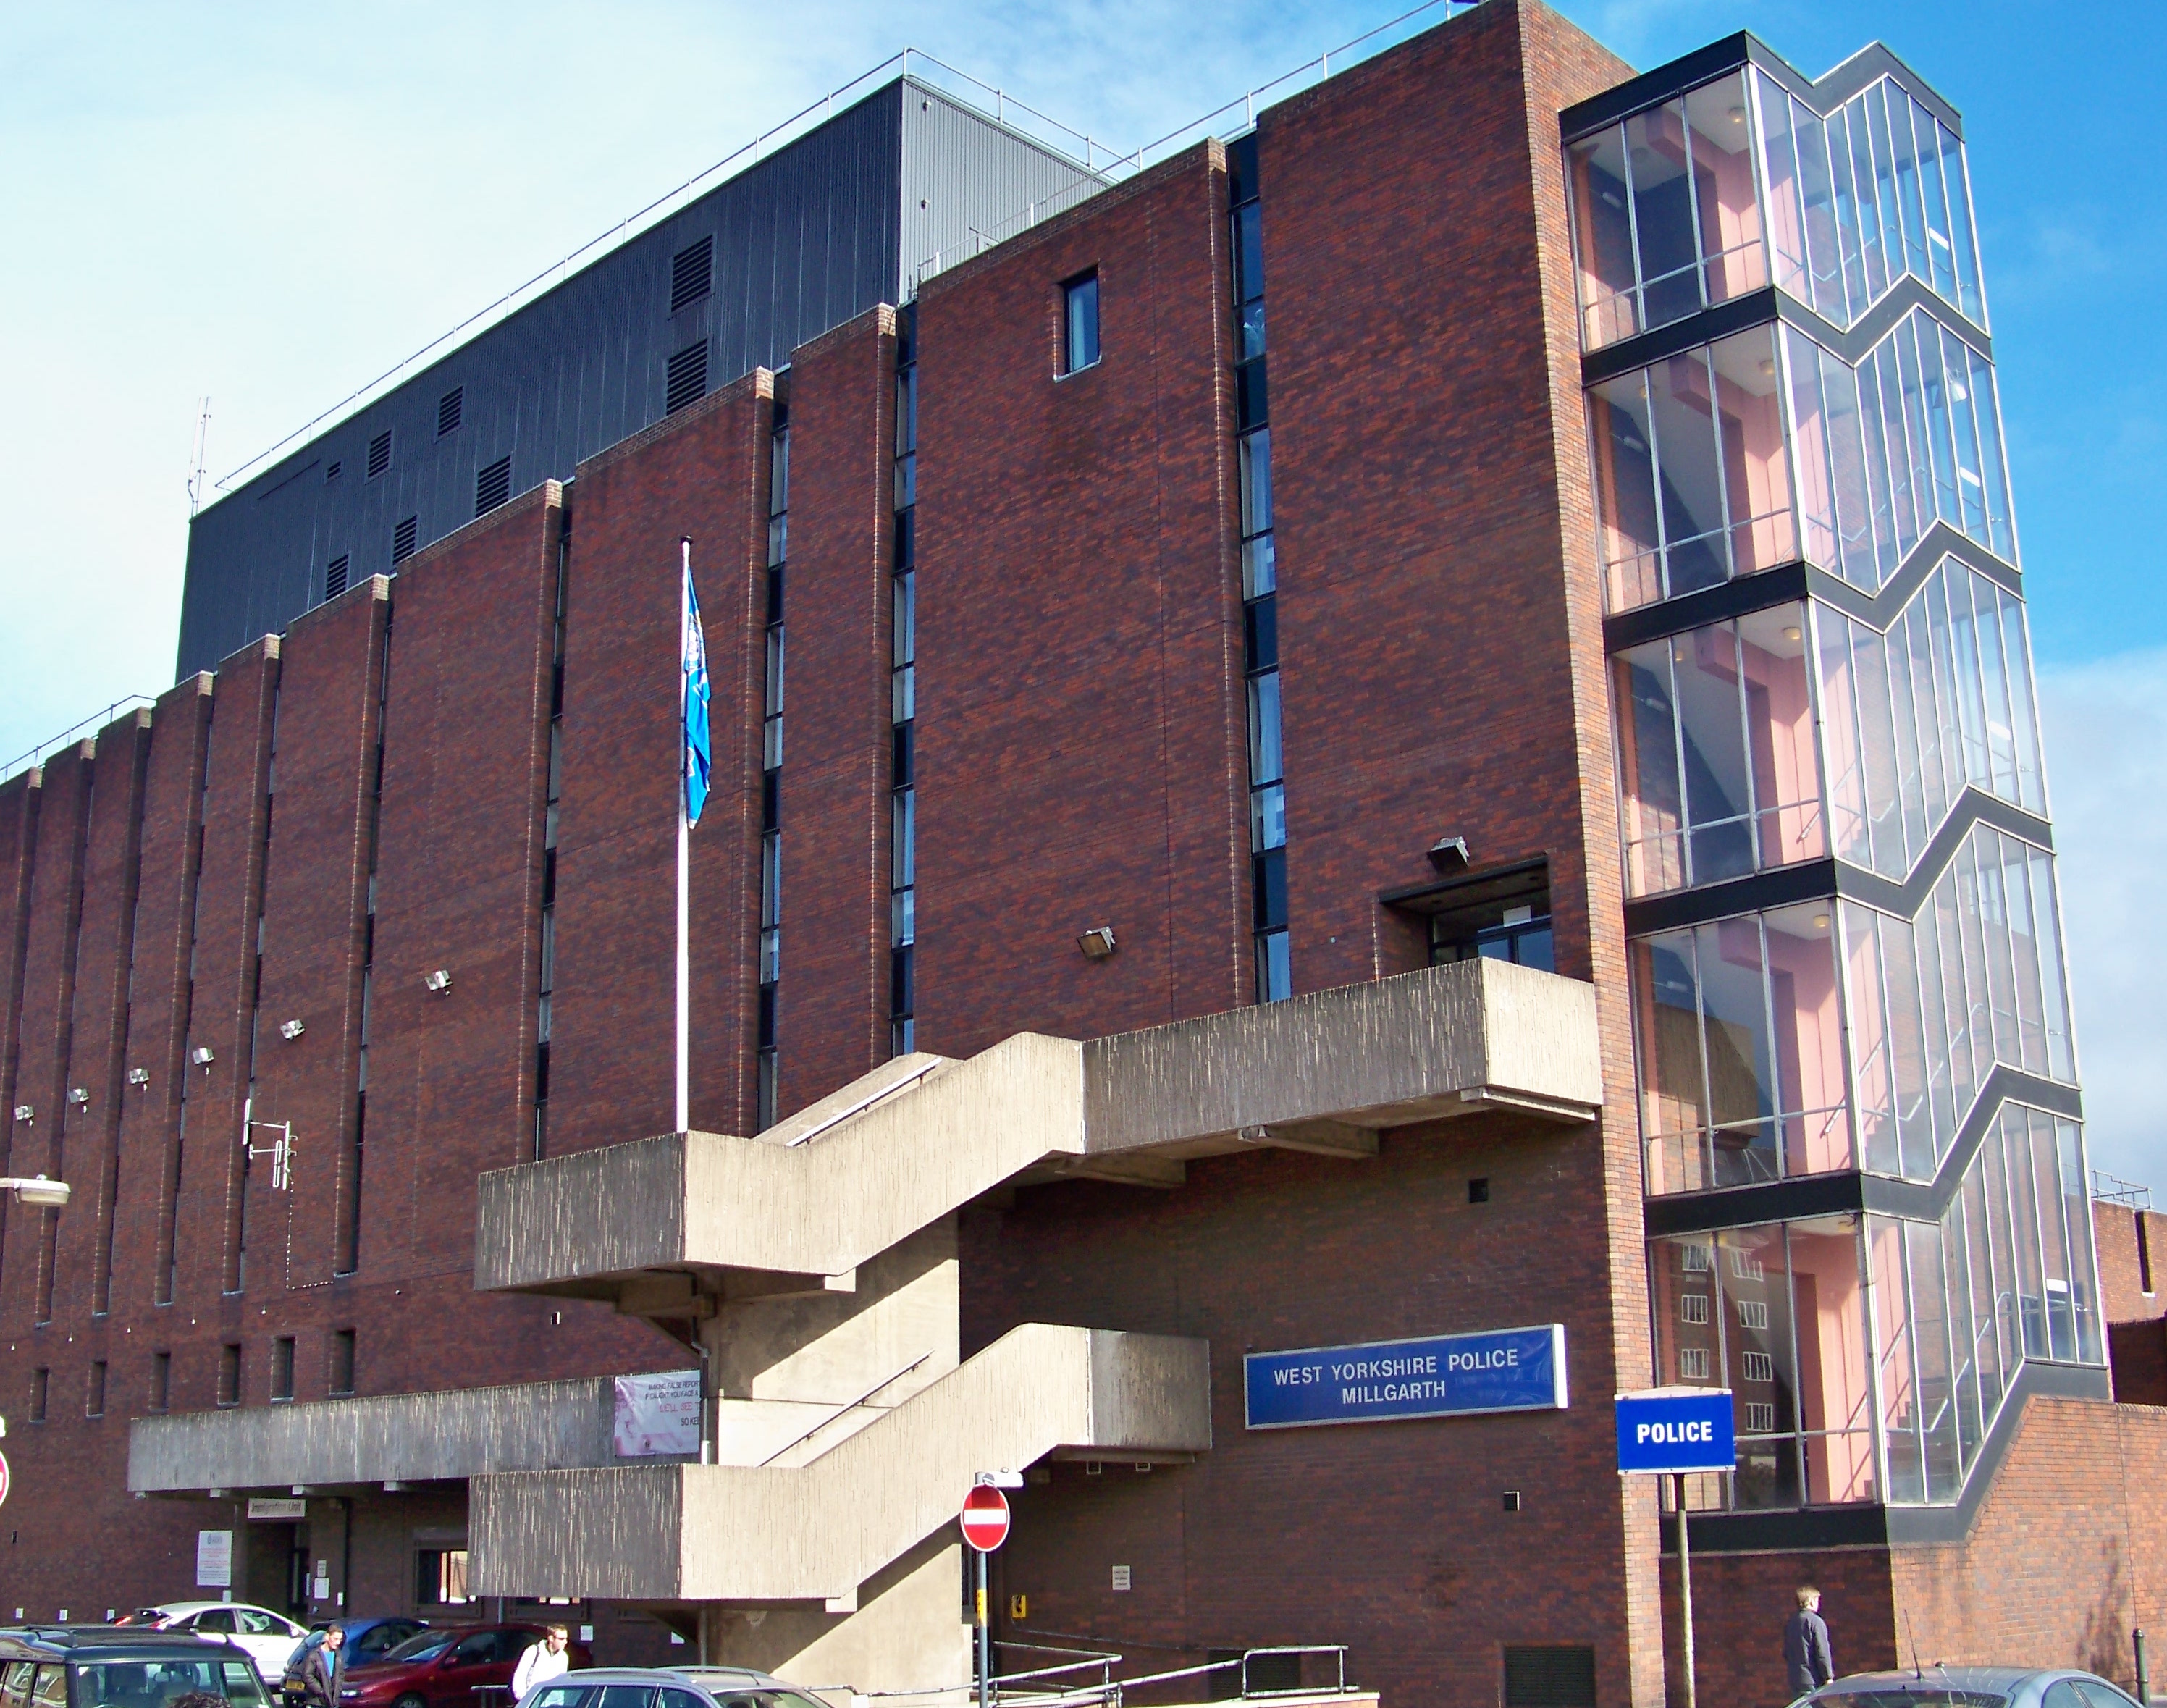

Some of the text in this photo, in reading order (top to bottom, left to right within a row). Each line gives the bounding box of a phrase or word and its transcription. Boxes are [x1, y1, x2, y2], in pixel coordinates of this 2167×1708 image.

[1274, 1348, 1518, 1386] WEST YORKSHIRE POLICE
[1342, 1380, 1446, 1405] MILLGARTH
[681, 1402, 693, 1411] SEE
[681, 1417, 689, 1426] SO
[1637, 1421, 1713, 1444] POLICE
